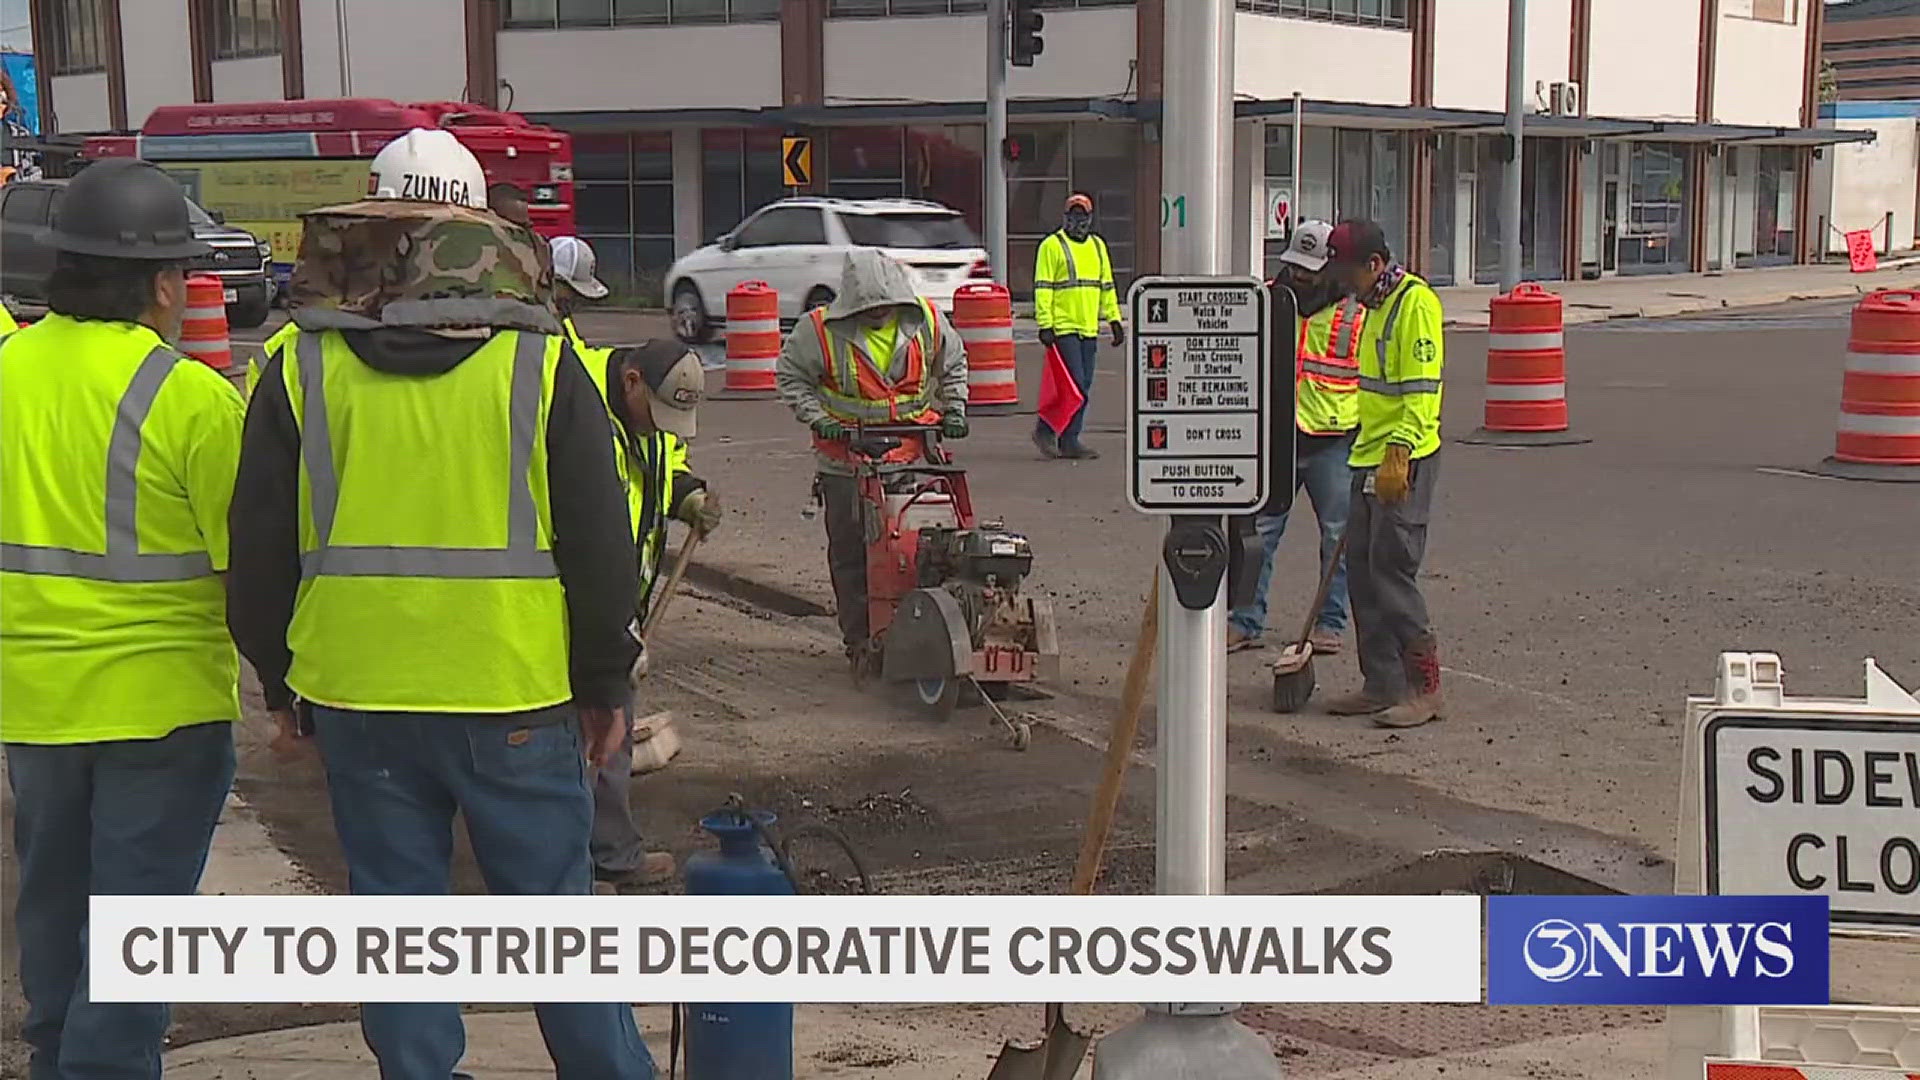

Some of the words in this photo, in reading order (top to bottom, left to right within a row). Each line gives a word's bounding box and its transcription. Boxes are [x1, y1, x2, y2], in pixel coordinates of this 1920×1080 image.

[402, 174, 470, 207] ZUNIGA
[1177, 291, 1203, 304] START
[1206, 291, 1249, 304] CROSSING
[1192, 306, 1216, 317] Watch
[1197, 318, 1229, 330] Vehicles
[1186, 338, 1211, 348] DON'T
[1214, 337, 1239, 348] START
[1183, 351, 1206, 362] Finish
[1210, 351, 1243, 365] Crossing
[1204, 363, 1232, 374] Started
[1178, 382, 1198, 393] TIME
[1201, 381, 1249, 393] REMAINING
[1191, 394, 1213, 406] Finish
[1217, 394, 1249, 408] Crossing
[1186, 428, 1211, 440] DON'T
[1215, 428, 1242, 440] CROSS
[1162, 465, 1191, 477] PUSH
[1195, 465, 1234, 477] BUTTON
[1172, 486, 1185, 497] TO
[1189, 486, 1224, 497] CROSS
[1746, 746, 1920, 808] SIDE
